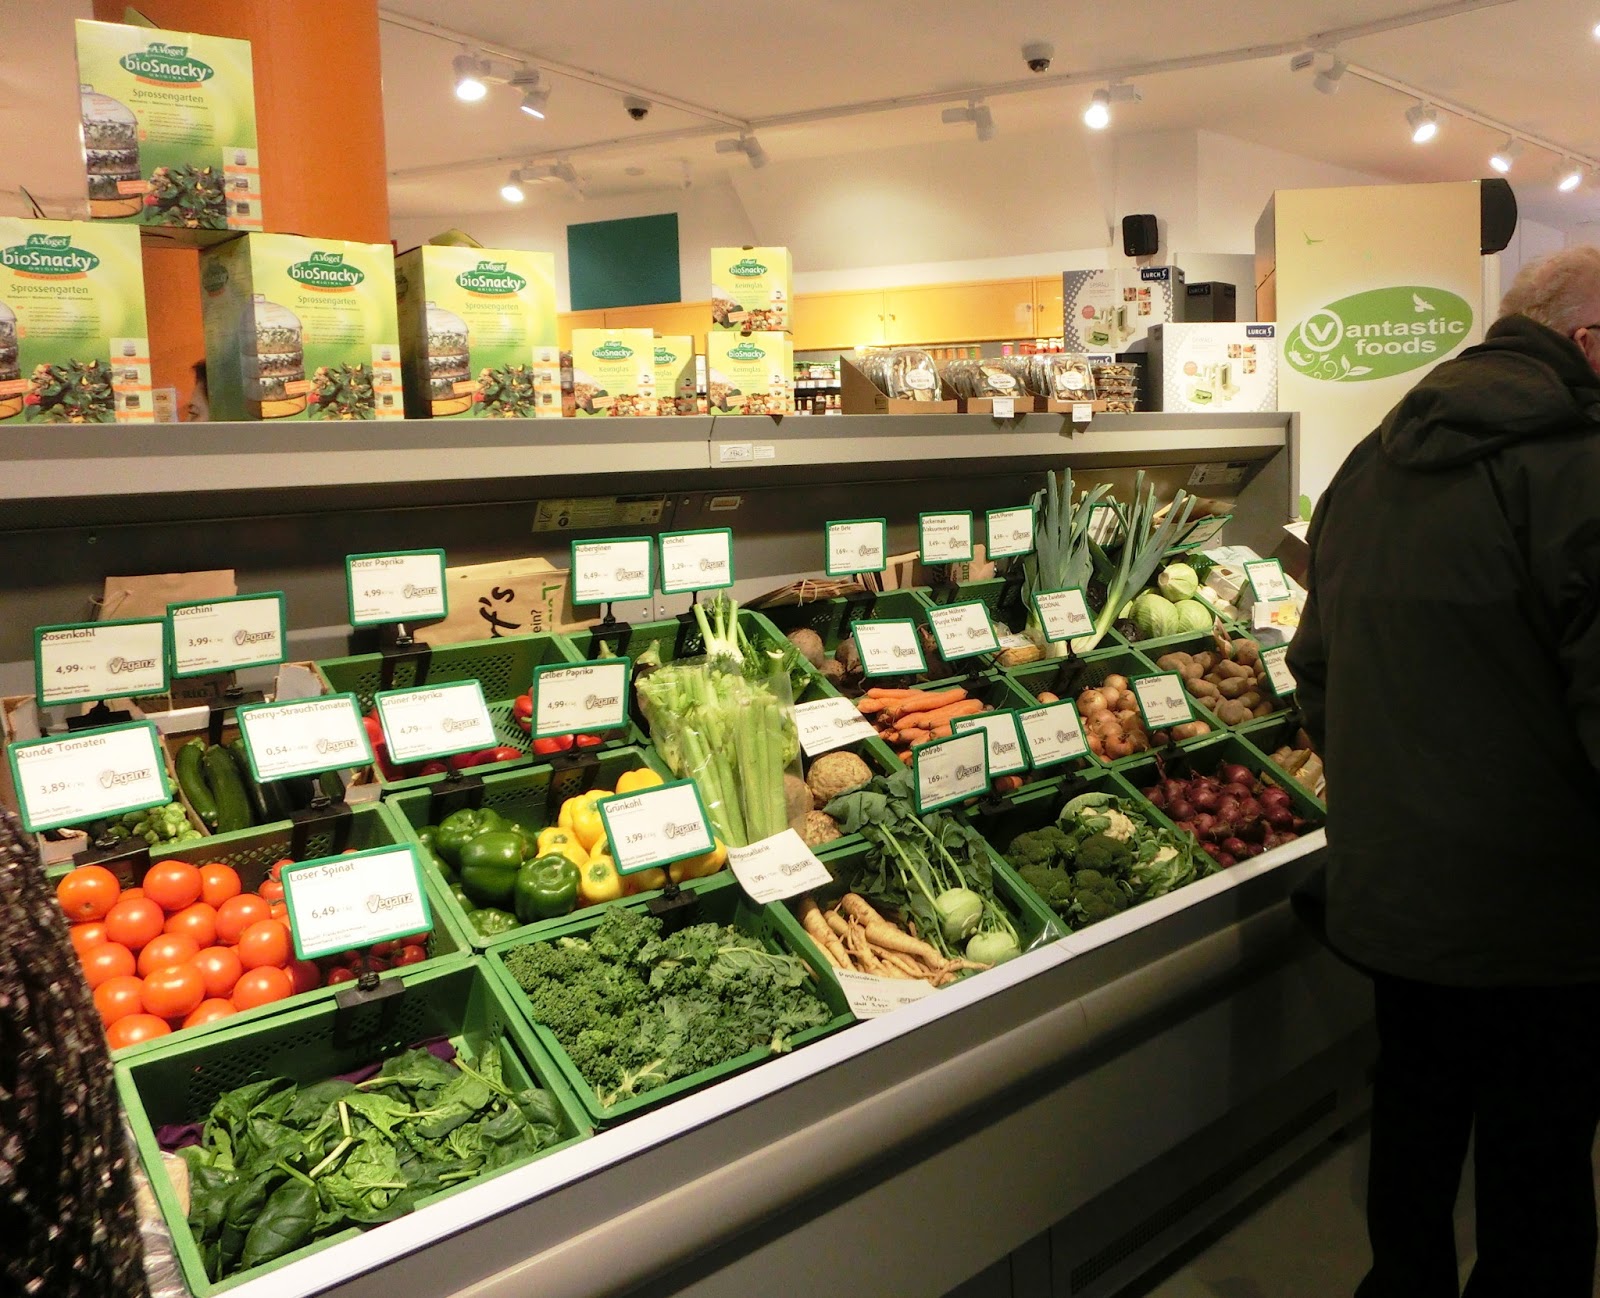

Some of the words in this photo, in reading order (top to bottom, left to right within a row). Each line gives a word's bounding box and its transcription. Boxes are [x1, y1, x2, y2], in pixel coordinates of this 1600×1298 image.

[133, 88, 204, 103] Sprossengarten
[1142, 271, 1161, 279] LURCH
[11, 283, 89, 295] Sprossengarten
[298, 295, 357, 306] Sprossengarten
[465, 302, 519, 311] Sprossengarten
[1247, 328, 1266, 336] LURCH
[1355, 337, 1437, 356] foods
[351, 559, 372, 568] Roter
[375, 558, 404, 567] Paprika
[672, 562, 684, 570] 3,29
[583, 572, 598, 580] 6,49
[364, 588, 382, 597] 4,99
[173, 604, 213, 617] Zucchini
[41, 628, 96, 641] Rosenkohl
[235, 629, 276, 646] Veganz
[188, 637, 209, 647] 3,99
[55, 664, 79, 675] 4,99
[109, 657, 156, 675] Veganz
[566, 667, 593, 678] Paprika
[412, 691, 443, 702] Paprika
[547, 701, 564, 709] 4,99
[244, 701, 351, 722] Cherry-StrauchTomaten
[400, 725, 418, 735] 4,79
[316, 738, 357, 754] Veganz
[1033, 736, 1045, 745] 3,29
[17, 745, 53, 760] Runde
[58, 738, 106, 752] Tomaten
[266, 745, 287, 756] 0,54
[100, 767, 152, 789] Veganz
[40, 781, 66, 795] 3,89
[605, 798, 642, 814] Grünkohl
[665, 821, 701, 839] Veganz
[626, 832, 643, 844] 3,99
[290, 870, 318, 883] Loser
[322, 862, 355, 877] Spinat
[366, 892, 414, 914] Veganz
[311, 906, 335, 919] 6,49
